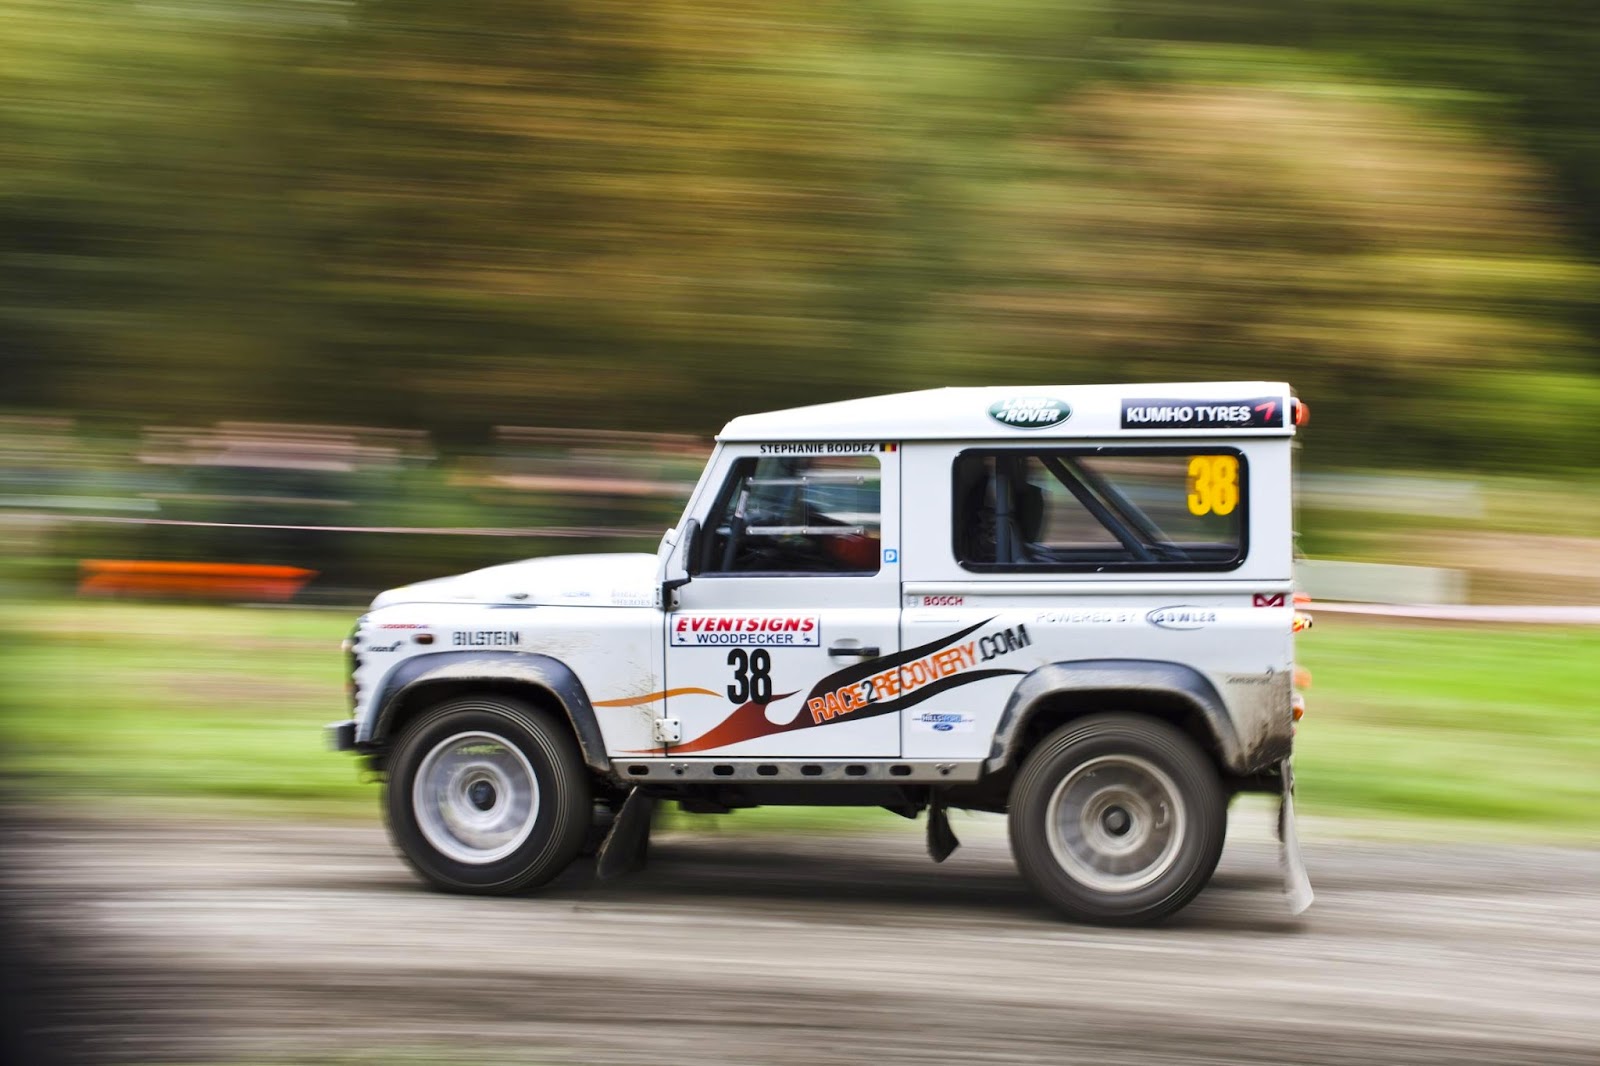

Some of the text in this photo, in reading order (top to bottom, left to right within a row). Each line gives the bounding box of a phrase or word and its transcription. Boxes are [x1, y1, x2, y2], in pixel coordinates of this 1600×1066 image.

[1005, 409, 1060, 421] ROVER
[1126, 406, 1251, 422] KUMHO TYRES
[760, 443, 875, 454] STEPHANIE BODDEZ
[1187, 455, 1239, 516] 38
[923, 596, 963, 606] BOSCH
[1035, 612, 1111, 623] POWERED
[1156, 613, 1217, 623] BOWLER
[675, 617, 814, 632] EVENTSIGNS
[452, 631, 519, 646] BILSTEIN
[696, 633, 794, 644] WOODPECKER
[727, 648, 772, 705] 38
[807, 623, 1032, 725] RACE2RECOVERY.COM
